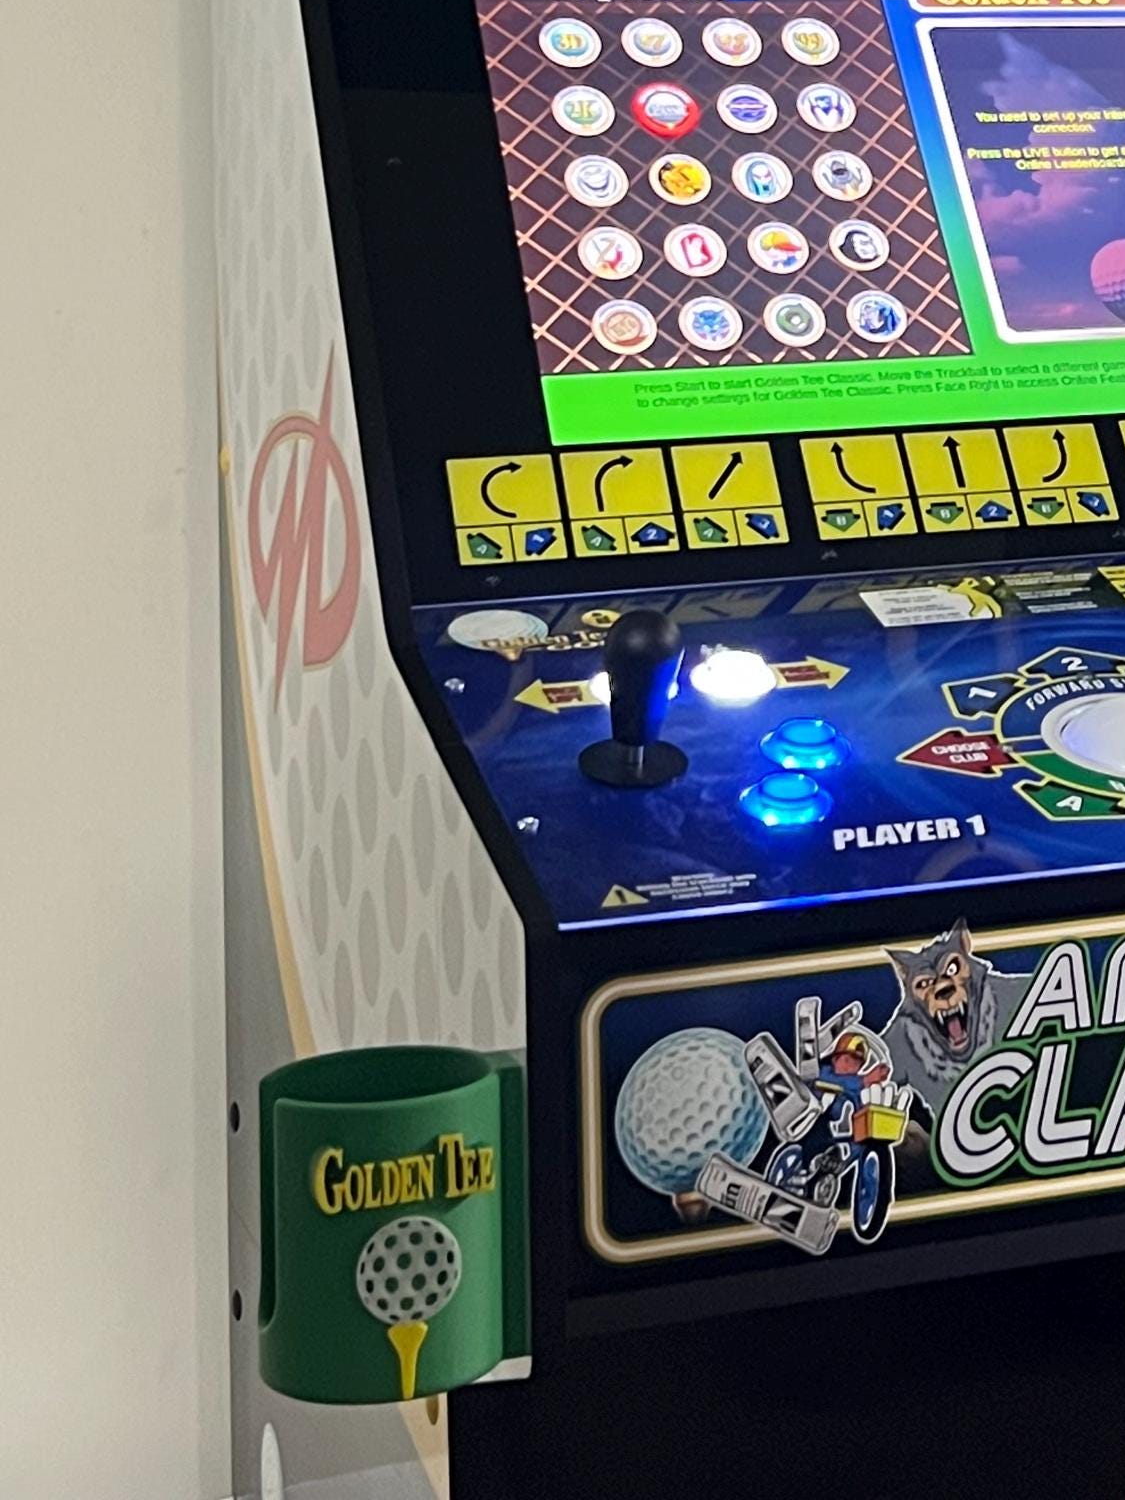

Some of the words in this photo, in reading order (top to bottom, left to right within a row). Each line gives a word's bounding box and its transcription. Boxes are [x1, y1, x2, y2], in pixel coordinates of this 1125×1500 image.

[975, 111, 997, 123] You
[999, 111, 1027, 123] need
[1028, 111, 1041, 122] to
[967, 148, 1001, 159] Press
[1003, 148, 1022, 158] the
[634, 382, 673, 393] Press
[675, 380, 706, 392] Start
[708, 380, 721, 390] to
[723, 379, 753, 390] start
[754, 376, 799, 388] Golden
[802, 374, 825, 385] Tee
[878, 370, 912, 381] Move
[914, 369, 932, 379] the
[1005, 364, 1039, 375] select
[774, 388, 818, 400] Golden
[821, 386, 843, 397] Tee
[897, 382, 933, 393] Press
[1060, 656, 1089, 672] 2
[968, 686, 998, 699] 1
[1025, 677, 1106, 712] FORWARD
[931, 741, 991, 755] CHOOSE
[949, 752, 989, 764] CLUB
[1055, 795, 1083, 812] A
[833, 817, 961, 851] PLAYER
[965, 814, 986, 836] 1
[313, 1146, 435, 1215] GOLDEN
[438, 1133, 496, 1200] TEE
